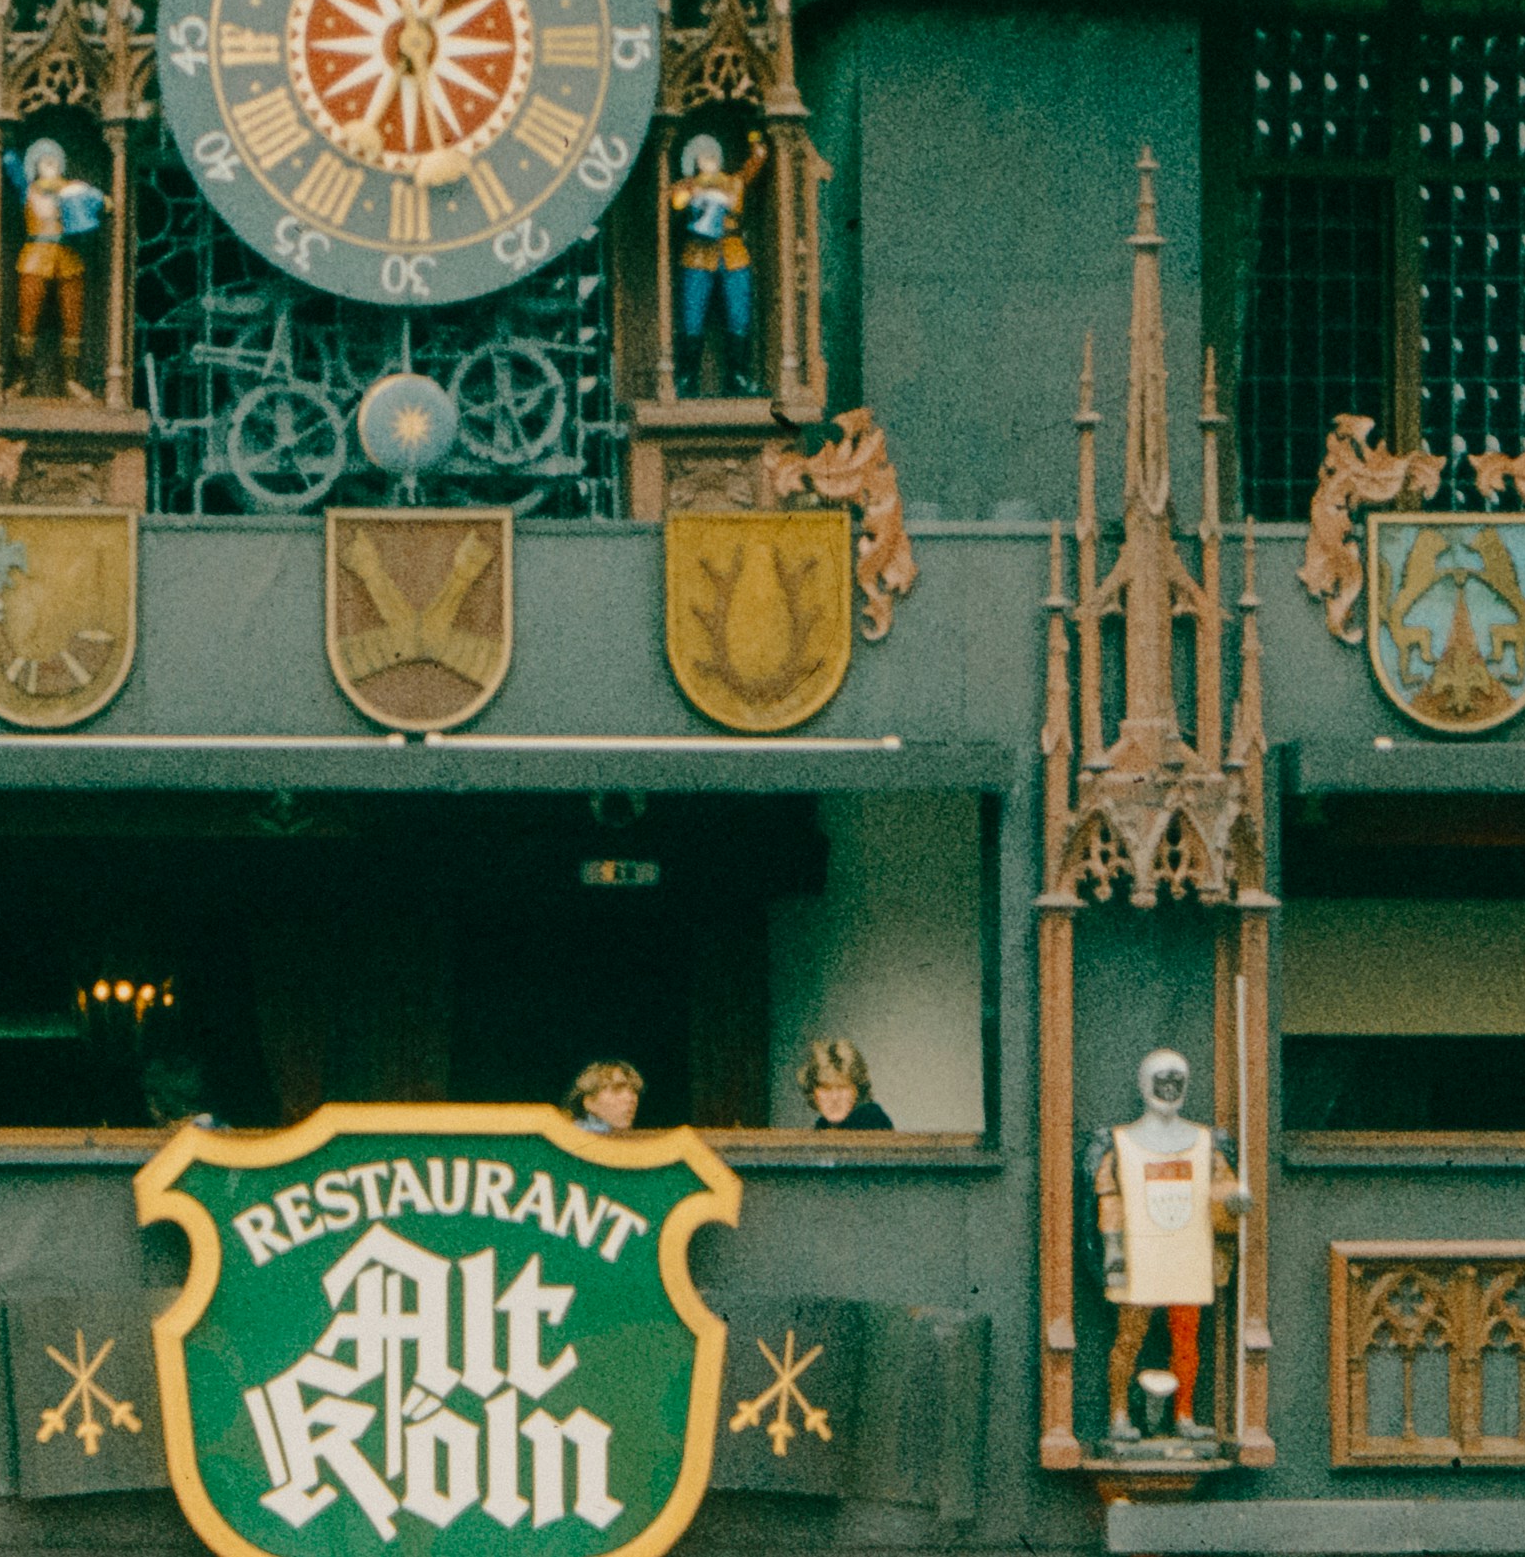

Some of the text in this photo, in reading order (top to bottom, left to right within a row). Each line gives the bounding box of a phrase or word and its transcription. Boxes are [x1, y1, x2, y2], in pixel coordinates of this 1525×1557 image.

[169, 15, 209, 75] 45
[219, 22, 280, 67] IX
[541, 24, 601, 68] III
[612, 25, 652, 69] 15
[193, 130, 242, 182] 40
[231, 84, 311, 171] VIII
[291, 150, 366, 225] VII
[577, 134, 630, 190] 20
[275, 215, 332, 273] 35
[491, 217, 551, 272] 25
[380, 254, 438, 297] 30
[232, 1158, 650, 1267] RESTAURANT
[313, 1222, 579, 1481] Alt
[243, 1352, 625, 1544] Köln
